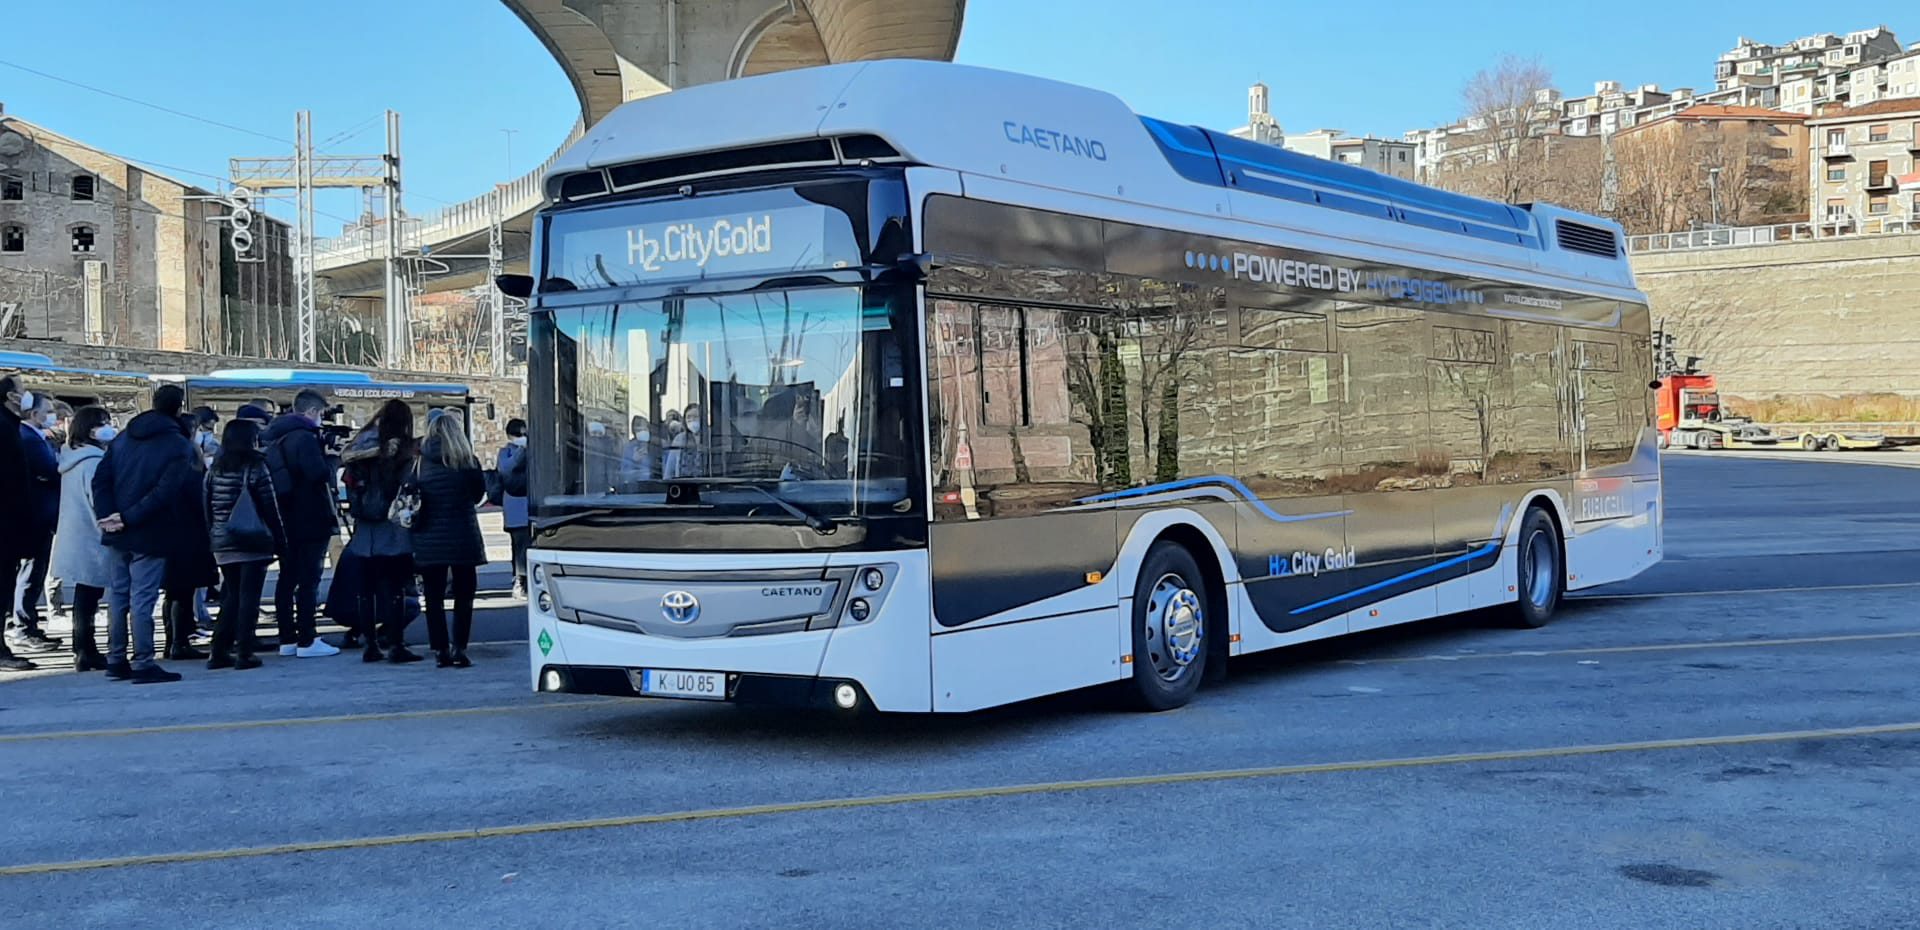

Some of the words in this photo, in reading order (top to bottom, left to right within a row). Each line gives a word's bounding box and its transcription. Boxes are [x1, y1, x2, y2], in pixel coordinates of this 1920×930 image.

[1003, 121, 1107, 161] CAETANO
[1233, 252, 1333, 290] POWERED
[1337, 267, 1361, 294] BY
[1324, 544, 1355, 570] Gold
[761, 586, 823, 597] CAETANO
